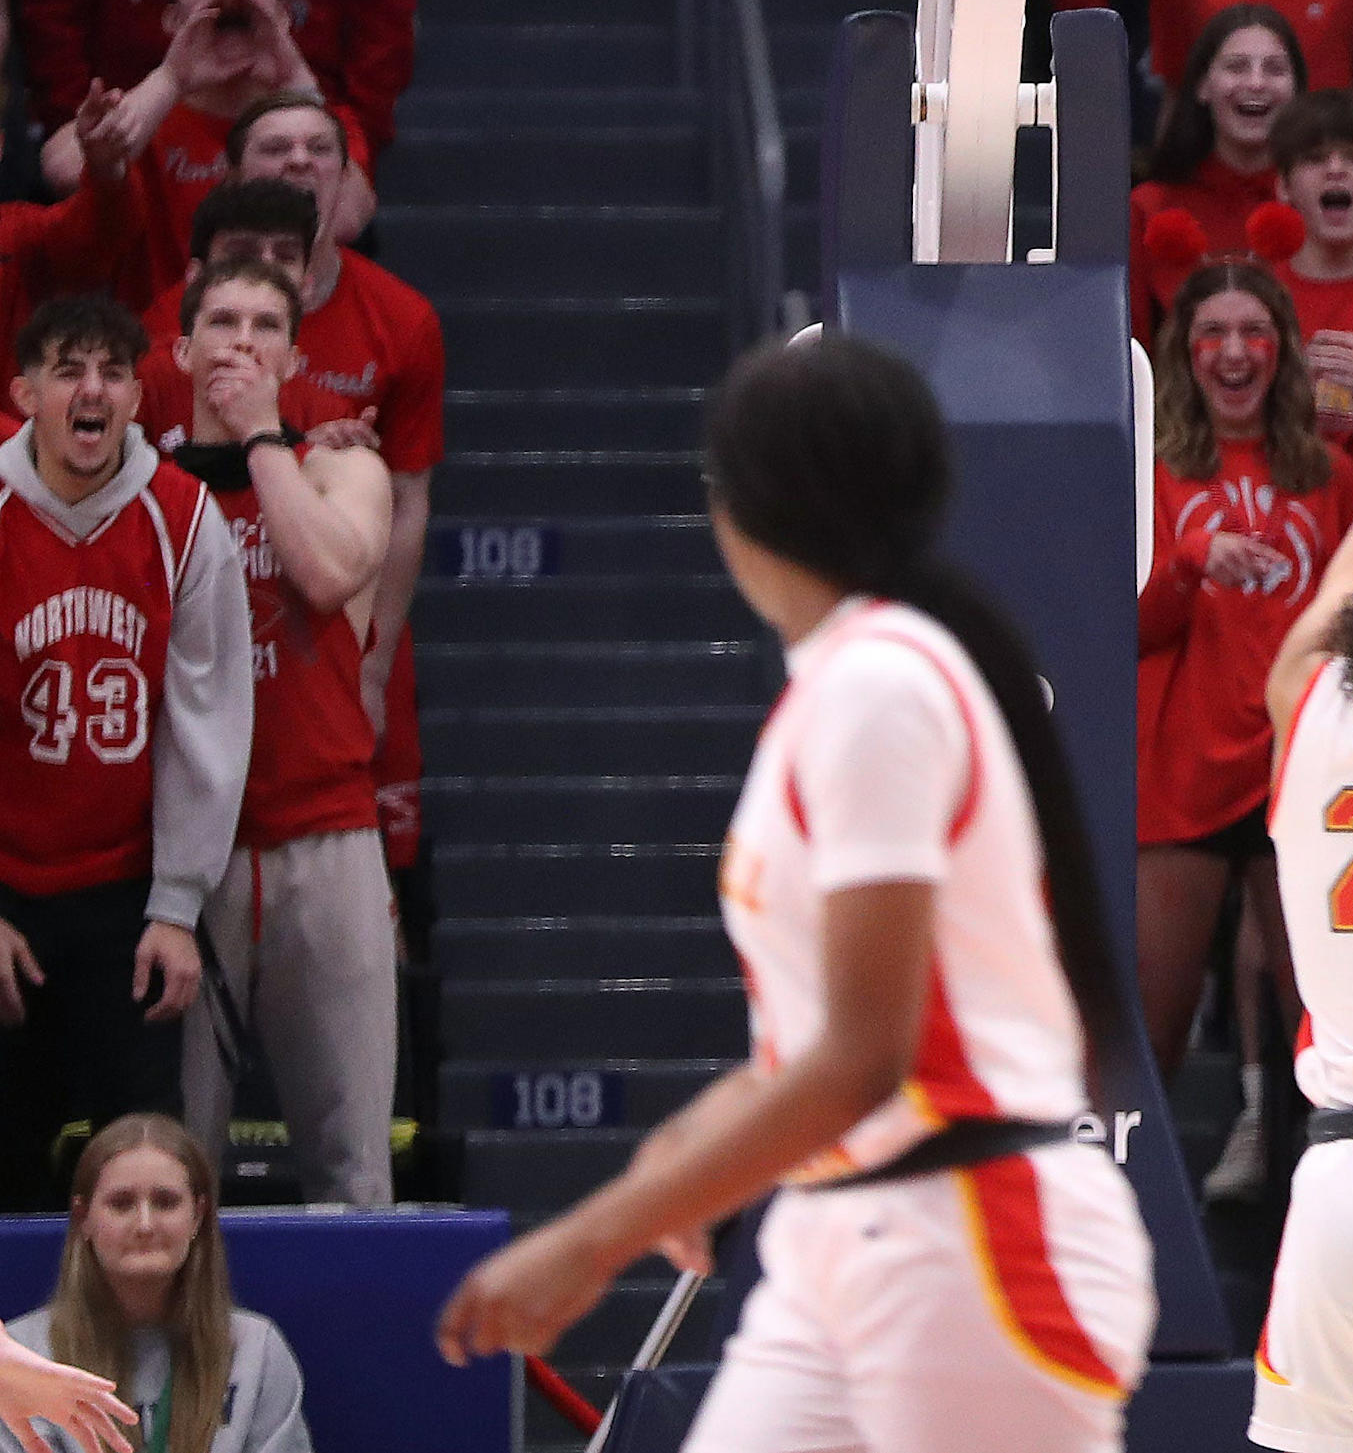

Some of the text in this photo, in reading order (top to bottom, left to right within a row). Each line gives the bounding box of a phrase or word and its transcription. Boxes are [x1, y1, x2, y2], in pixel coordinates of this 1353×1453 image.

[14, 586, 148, 663] NORTHWEST
[20, 657, 149, 765] 43
[513, 1071, 603, 1128] 108
